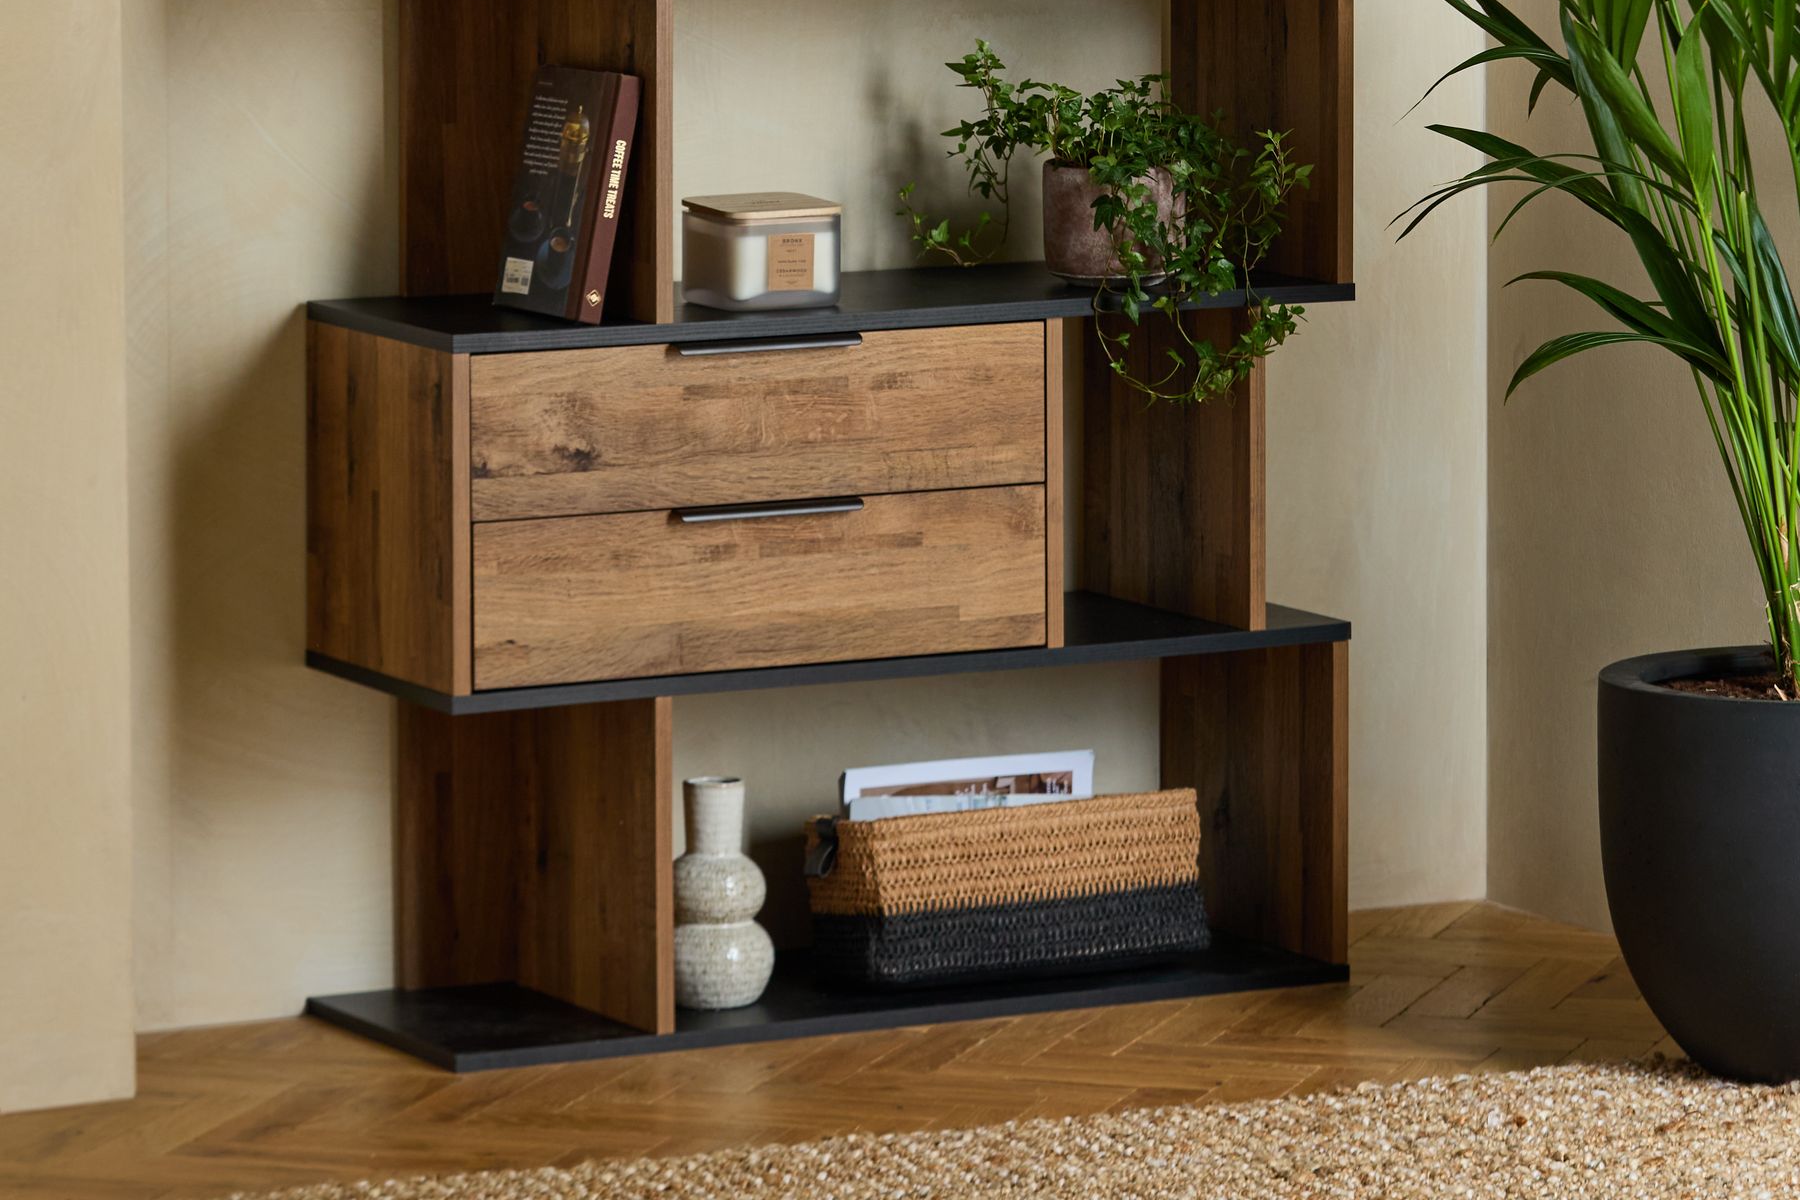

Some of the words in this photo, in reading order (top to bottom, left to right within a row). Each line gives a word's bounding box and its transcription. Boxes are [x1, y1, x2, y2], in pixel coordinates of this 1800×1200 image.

[612, 139, 627, 169] COFFEE
[608, 169, 622, 189] TIME
[603, 189, 618, 219] TREATS
